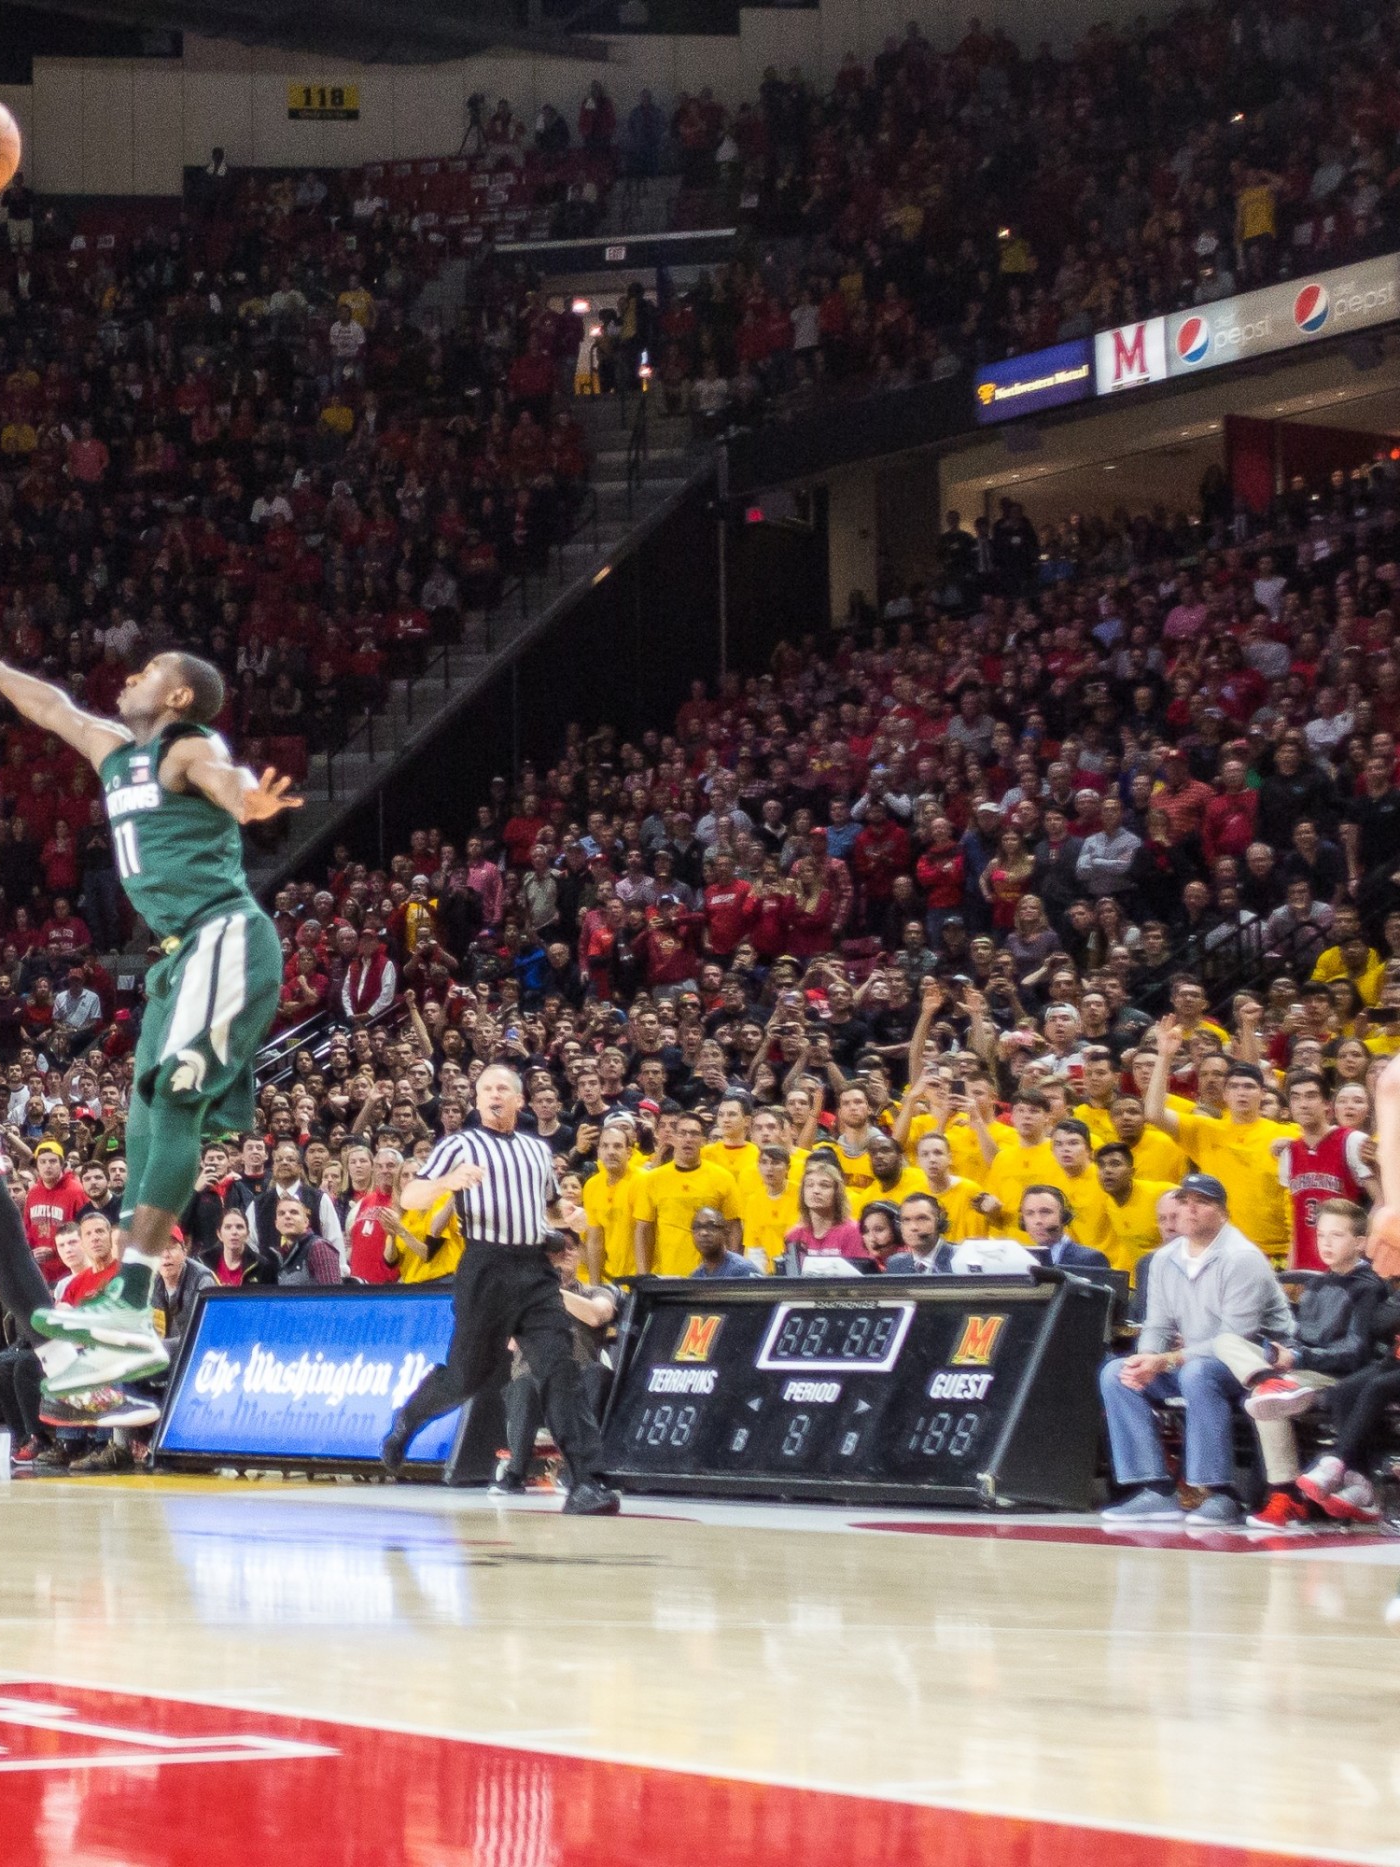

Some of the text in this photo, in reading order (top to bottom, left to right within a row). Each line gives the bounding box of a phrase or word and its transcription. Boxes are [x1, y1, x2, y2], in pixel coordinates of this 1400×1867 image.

[303, 87, 344, 107] 118
[1333, 280, 1395, 322] pepsi
[1112, 323, 1151, 381] M
[1213, 314, 1271, 354] pepsi
[675, 1315, 722, 1362] M
[951, 1315, 1005, 1365] M
[195, 1349, 241, 1400] The
[243, 1342, 393, 1407] Washington
[648, 1368, 718, 1394] TERRAPINS
[783, 1381, 842, 1403] PERIOD
[929, 1373, 995, 1400] GUEST
